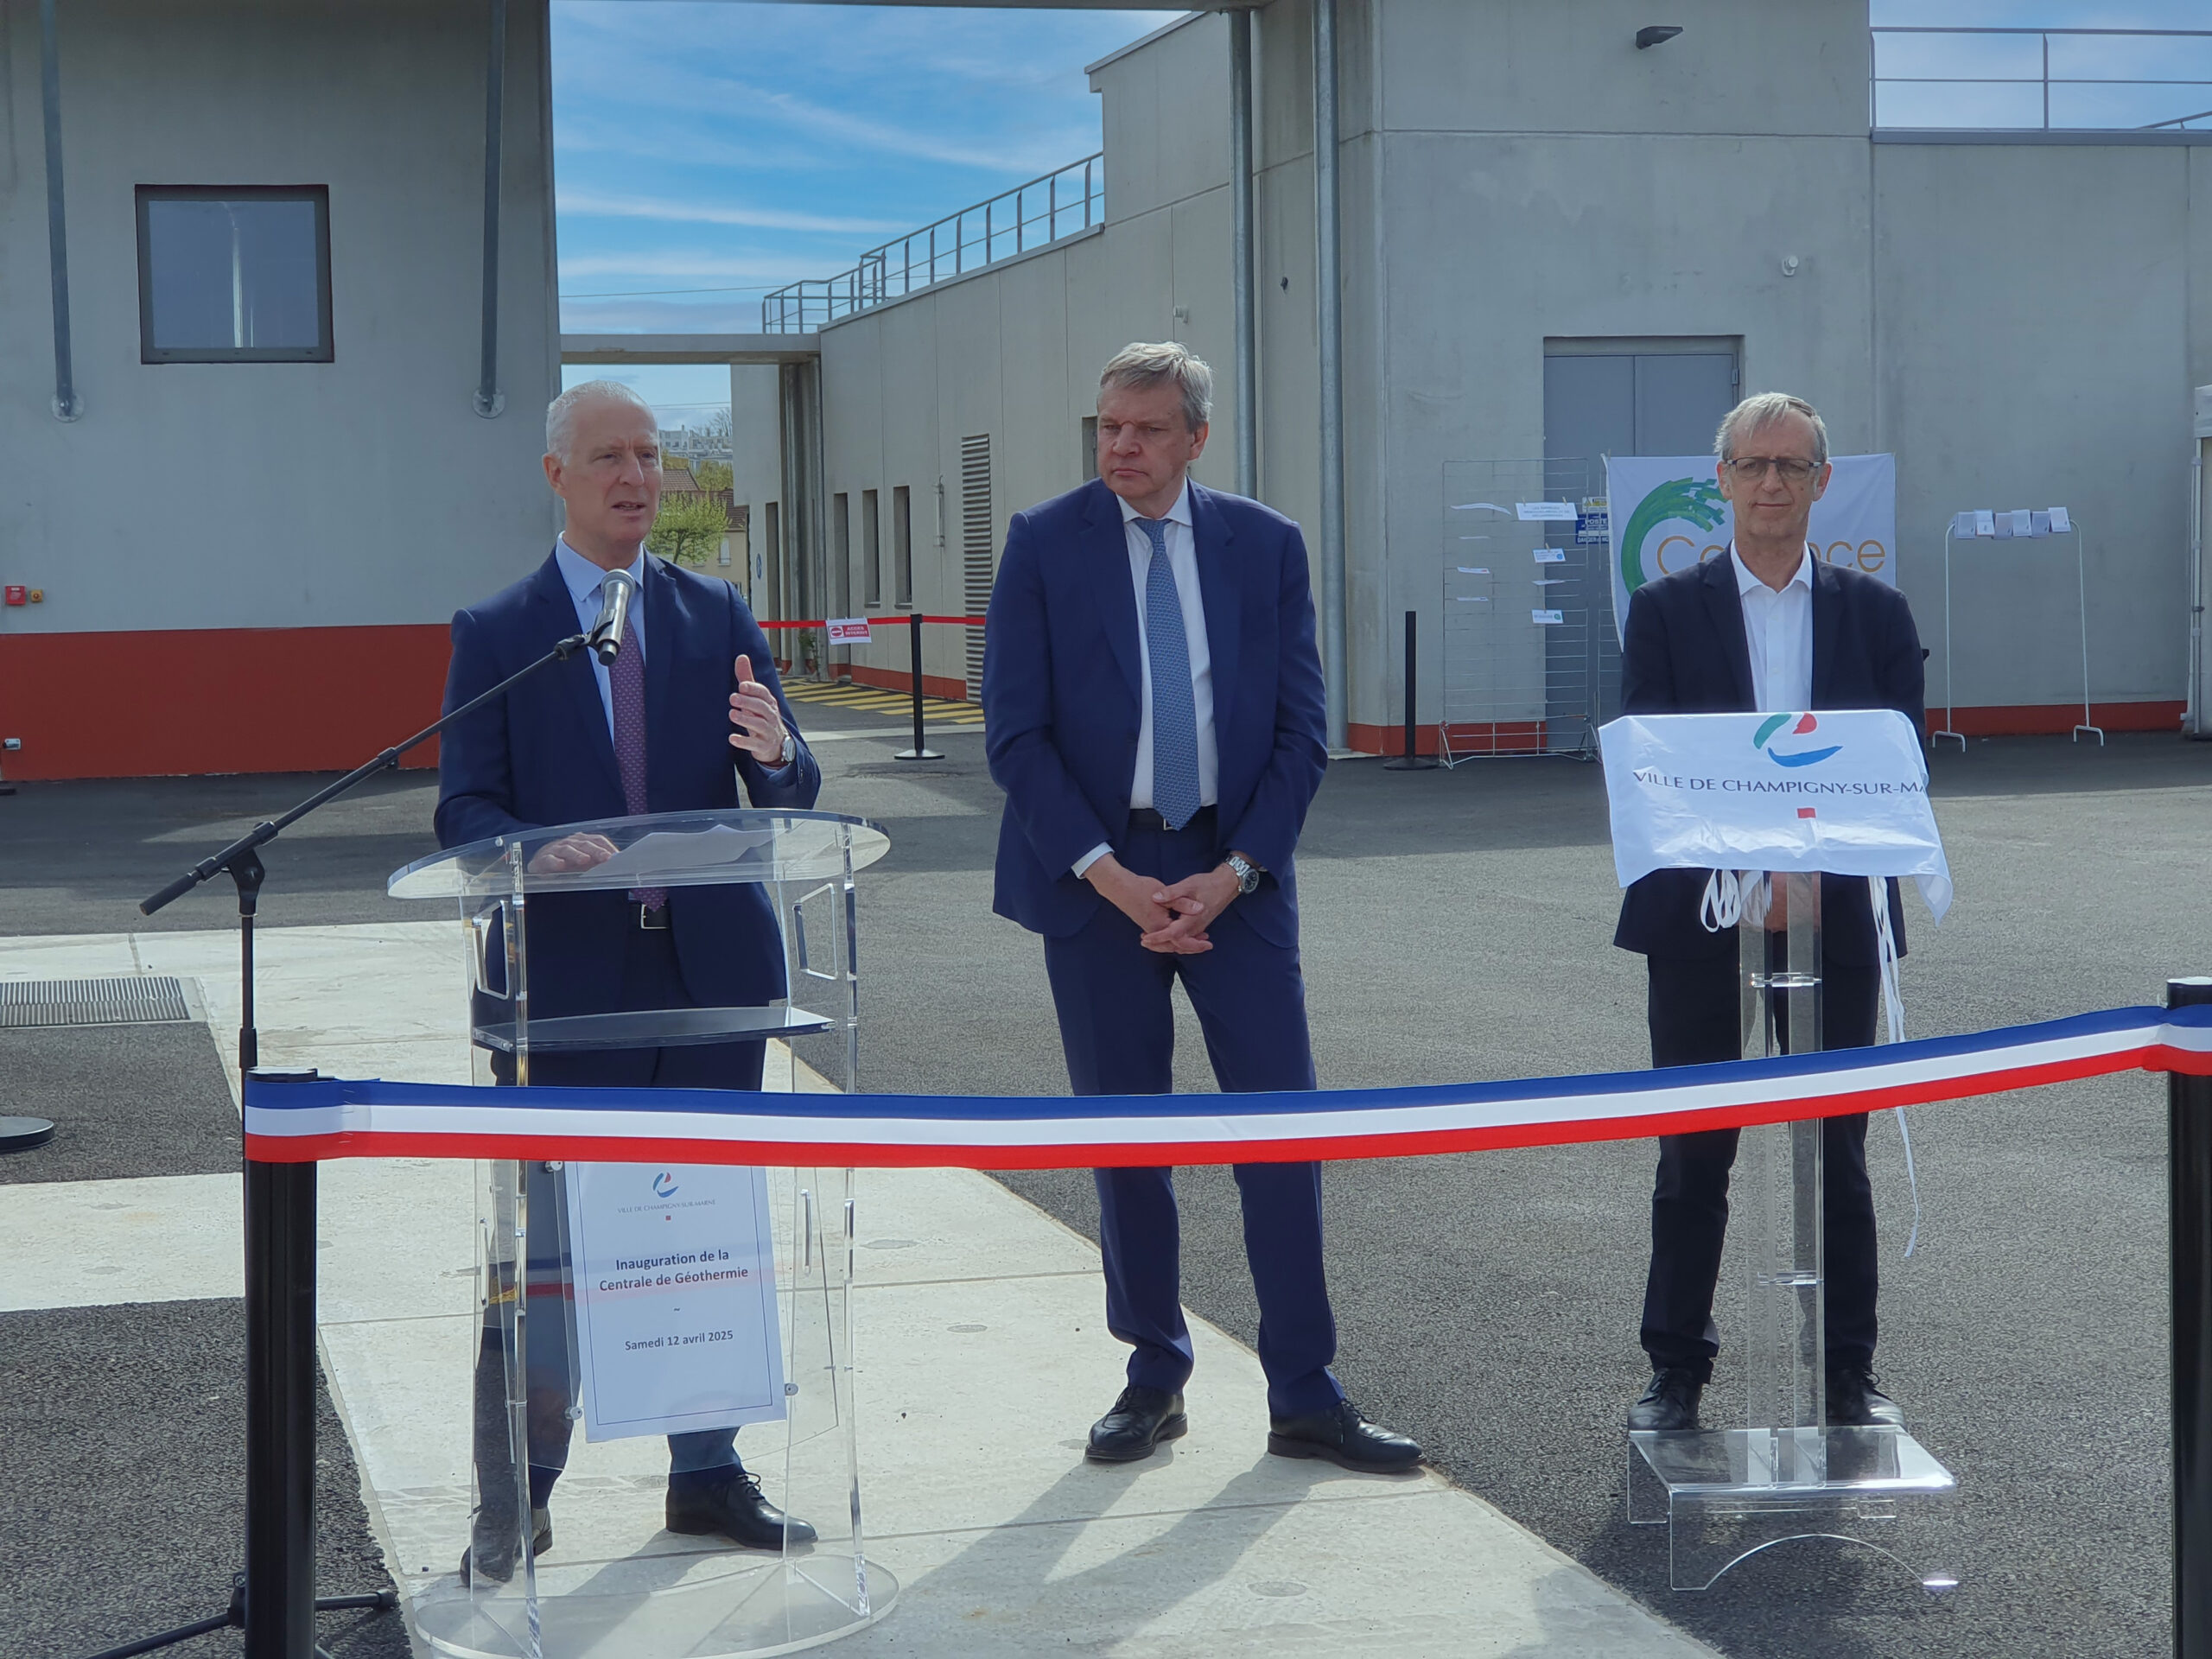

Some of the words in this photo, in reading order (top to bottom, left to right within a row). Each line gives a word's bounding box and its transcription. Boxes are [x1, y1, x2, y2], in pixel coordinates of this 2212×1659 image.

[1632, 772, 1684, 789] VILLE
[1690, 779, 1716, 791] DE
[616, 1253, 696, 1271] Inauguration
[700, 1251, 715, 1262] de
[718, 1249, 729, 1261] la
[600, 1275, 652, 1291] Centrale
[656, 1274, 671, 1286] de
[675, 1267, 748, 1285] Géothermie
[625, 1338, 664, 1351] Samedi
[667, 1336, 680, 1346] 12
[683, 1332, 705, 1344] avril
[709, 1330, 734, 1342] 2025
